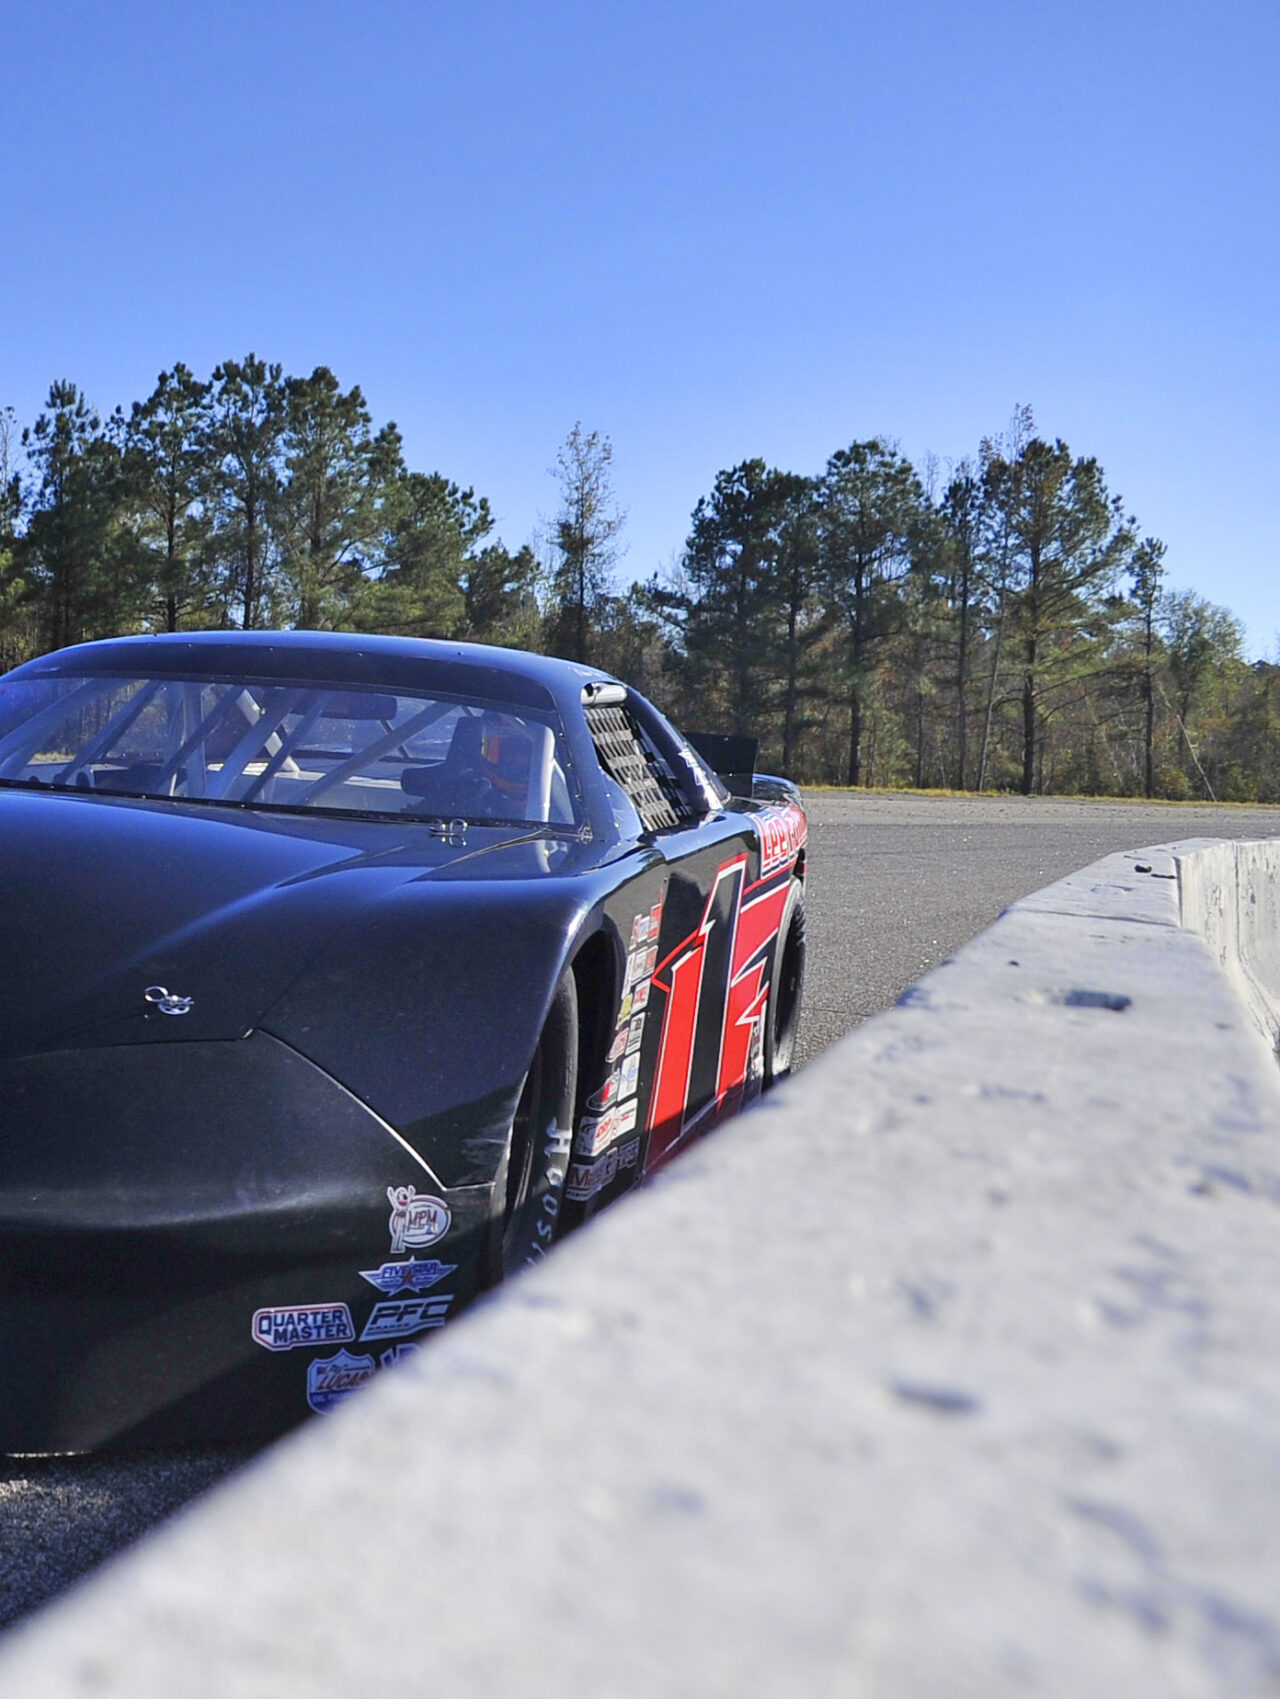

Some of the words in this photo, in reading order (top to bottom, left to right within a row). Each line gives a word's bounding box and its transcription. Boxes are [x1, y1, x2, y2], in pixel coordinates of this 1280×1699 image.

[524, 1117, 573, 1267] HOOSI
[258, 1309, 344, 1336] QUARTER
[370, 1300, 452, 1325] PFC
[273, 1323, 348, 1344] MASTER
